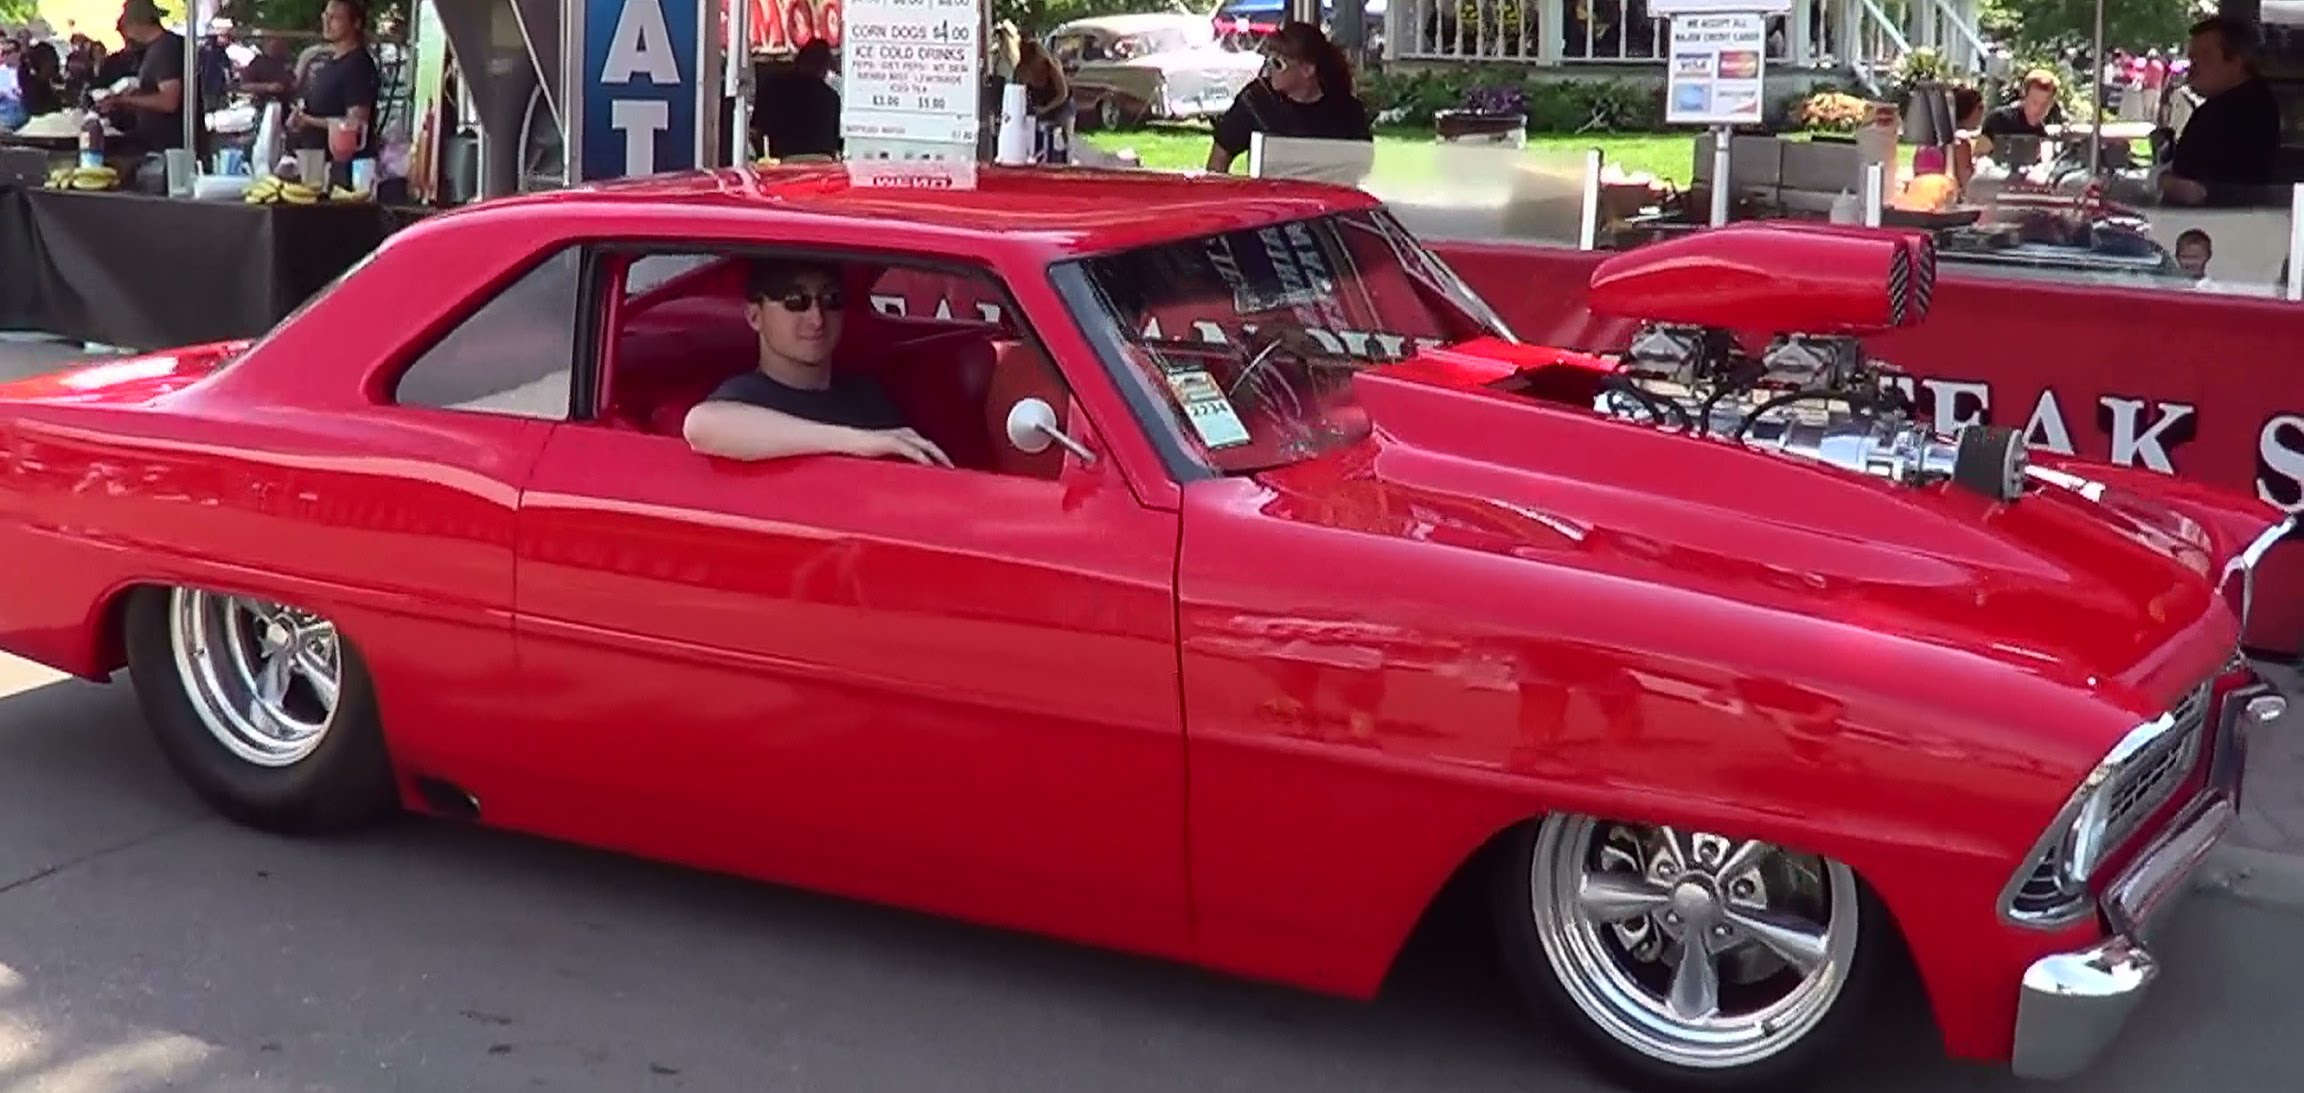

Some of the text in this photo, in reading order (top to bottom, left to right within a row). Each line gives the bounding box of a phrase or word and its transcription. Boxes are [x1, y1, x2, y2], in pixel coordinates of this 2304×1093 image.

[719, 0, 842, 48] MOO
[851, 24, 887, 38] CORN
[891, 25, 927, 39] DOGS
[855, 46, 965, 60] ICE COLD DRINKS
